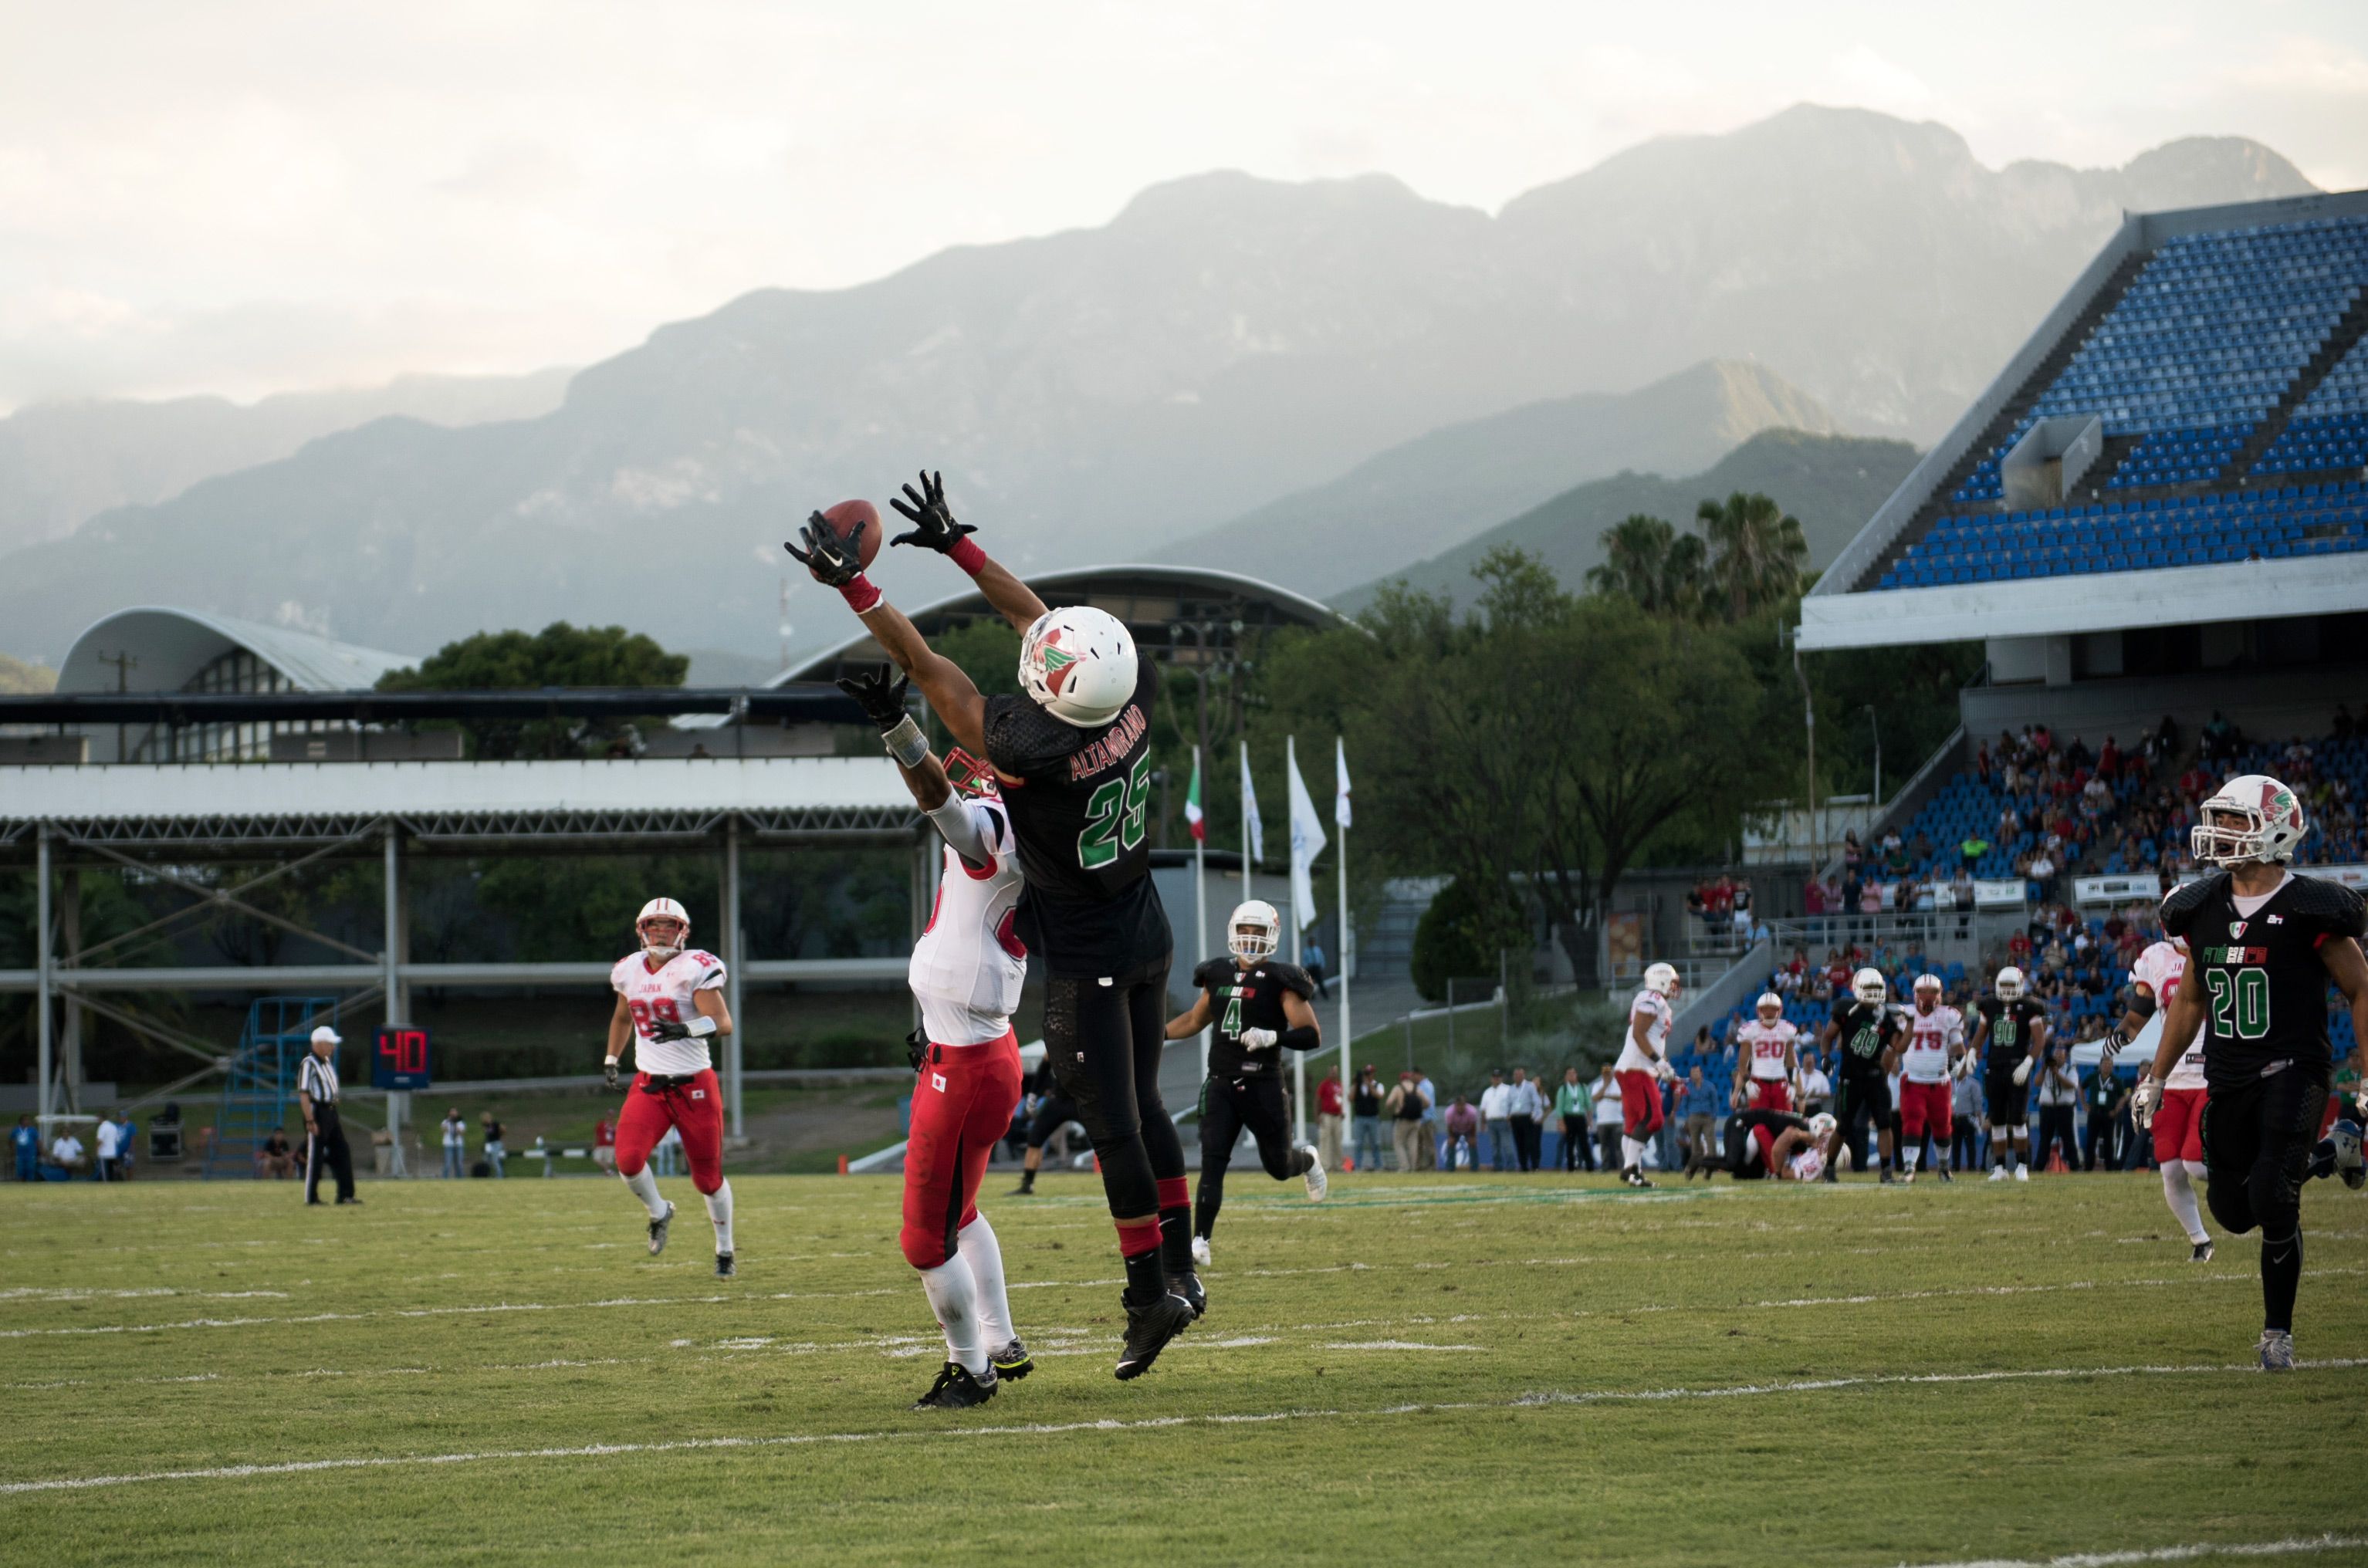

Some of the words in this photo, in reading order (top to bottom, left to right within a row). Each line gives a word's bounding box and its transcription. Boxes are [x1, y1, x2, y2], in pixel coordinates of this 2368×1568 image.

[1070, 705, 1146, 782] ALTAMIRANO
[1077, 745, 1149, 870] 25
[639, 983, 662, 993] JAPAN
[2205, 968, 2270, 1039] 20
[1221, 999, 1241, 1040] 4
[1994, 1020, 2017, 1046] 90
[380, 1031, 426, 1073] 40
[1755, 1040, 1784, 1058] 20
[1851, 1028, 1879, 1058] 49
